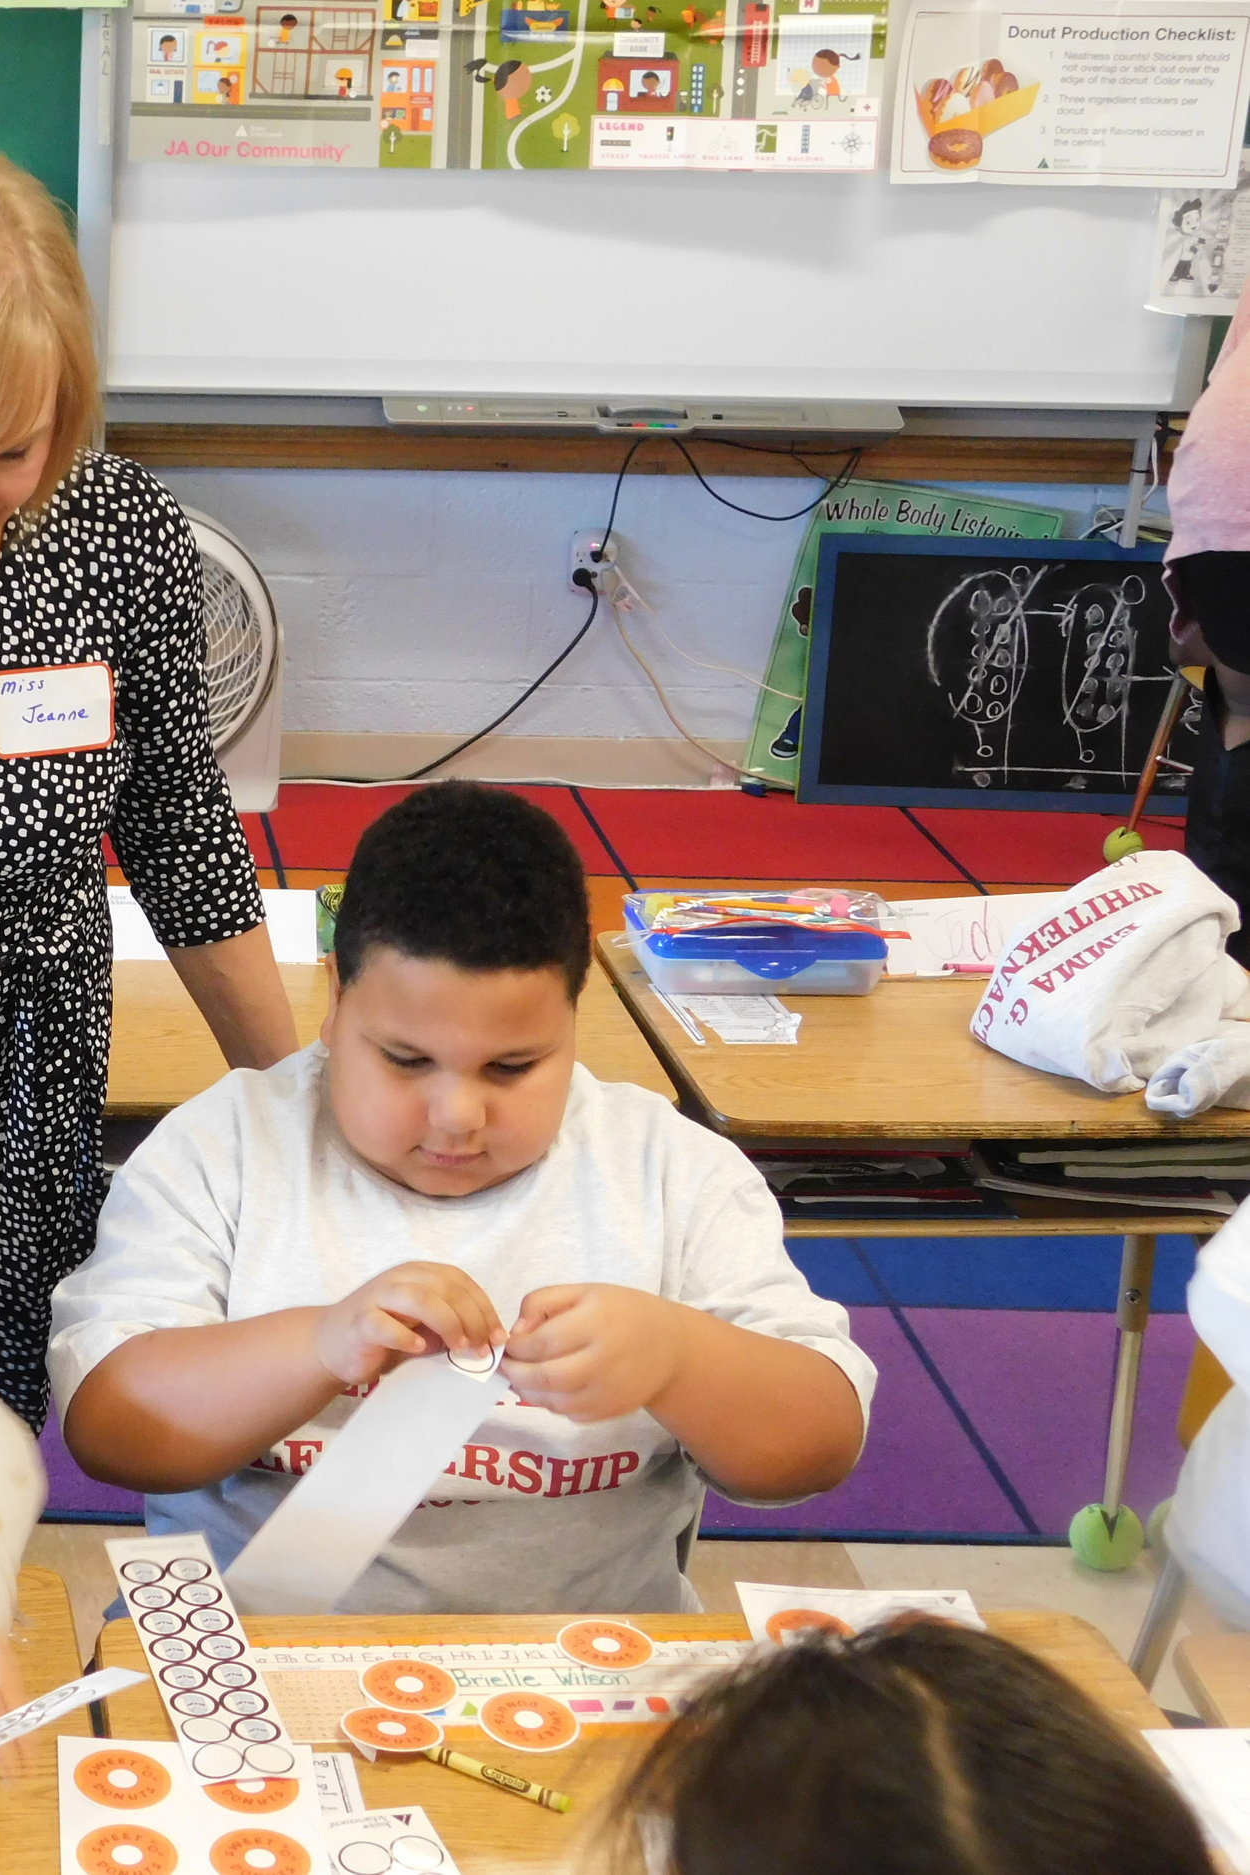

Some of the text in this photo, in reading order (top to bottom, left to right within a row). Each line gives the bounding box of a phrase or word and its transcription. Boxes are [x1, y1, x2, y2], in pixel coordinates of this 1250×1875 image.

[1008, 25, 1237, 42] Donut Production Checklist:
[1063, 51, 1111, 61] Neatness
[1153, 52, 1193, 61] Stickers
[1196, 53, 1231, 62] should
[1062, 64, 1078, 72] not
[1080, 64, 1117, 75] overlap
[1133, 64, 1157, 73] stick
[1159, 65, 1176, 74] out
[1203, 65, 1221, 74] the
[1060, 76, 1085, 87] edge
[1087, 76, 1099, 85] of
[1101, 76, 1117, 85] the
[1153, 76, 1182, 86] Color
[1059, 94, 1086, 104] Three
[1088, 95, 1138, 106] ingredient
[1139, 95, 1179, 105] stickers
[1181, 98, 1199, 107] per
[598, 122, 645, 131] LEGEND
[1054, 126, 1089, 136] Donuts
[1091, 128, 1107, 136] are
[1110, 126, 1150, 137] flavored
[1152, 127, 1193, 138] (colored
[1196, 129, 1206, 137] in
[165, 140, 191, 156] JA
[196, 140, 231, 158] Our
[1053, 138, 1069, 147] the
[826, 496, 889, 523] Whole
[895, 499, 948, 535] Body
[22, 704, 90, 724] Jeanne
[1028, 922, 1143, 994] EMMA
[451, 1667, 631, 1688] Brielle Wilson
[88, 1757, 137, 1777] SWEET
[483, 1766, 526, 1790] Crayola
[92, 1782, 156, 1801] DONUTS
[221, 1788, 285, 1806] DONUTS
[92, 1832, 143, 1854] SWEET
[225, 1836, 275, 1857] SWEET
